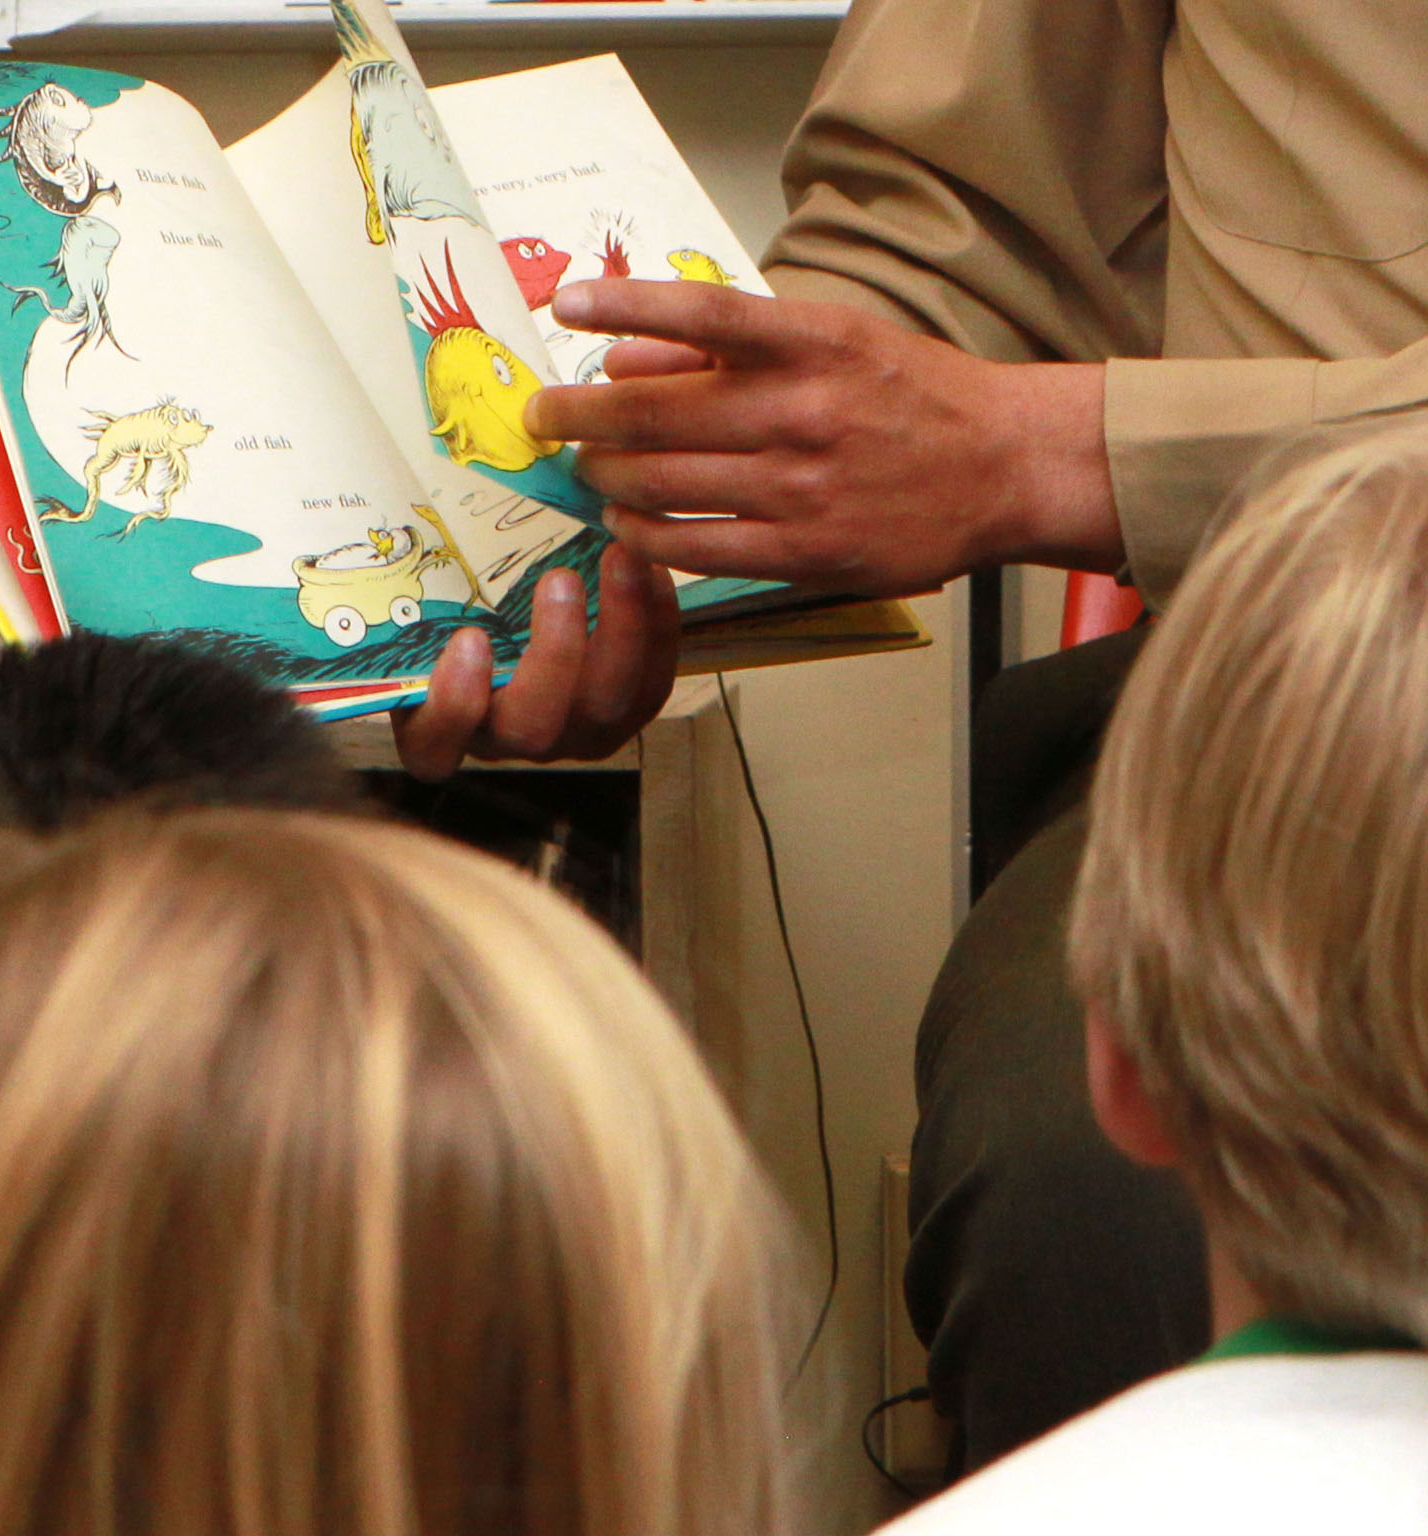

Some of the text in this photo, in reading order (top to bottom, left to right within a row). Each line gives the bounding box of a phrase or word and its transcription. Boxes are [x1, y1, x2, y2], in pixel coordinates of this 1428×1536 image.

[135, 167, 207, 191] Black fish
[472, 186, 488, 198] re
[491, 178, 533, 191] very,
[533, 169, 568, 183] very
[160, 229, 224, 248] blue fish
[234, 433, 293, 452] old fish
[300, 492, 372, 510] new fish.
